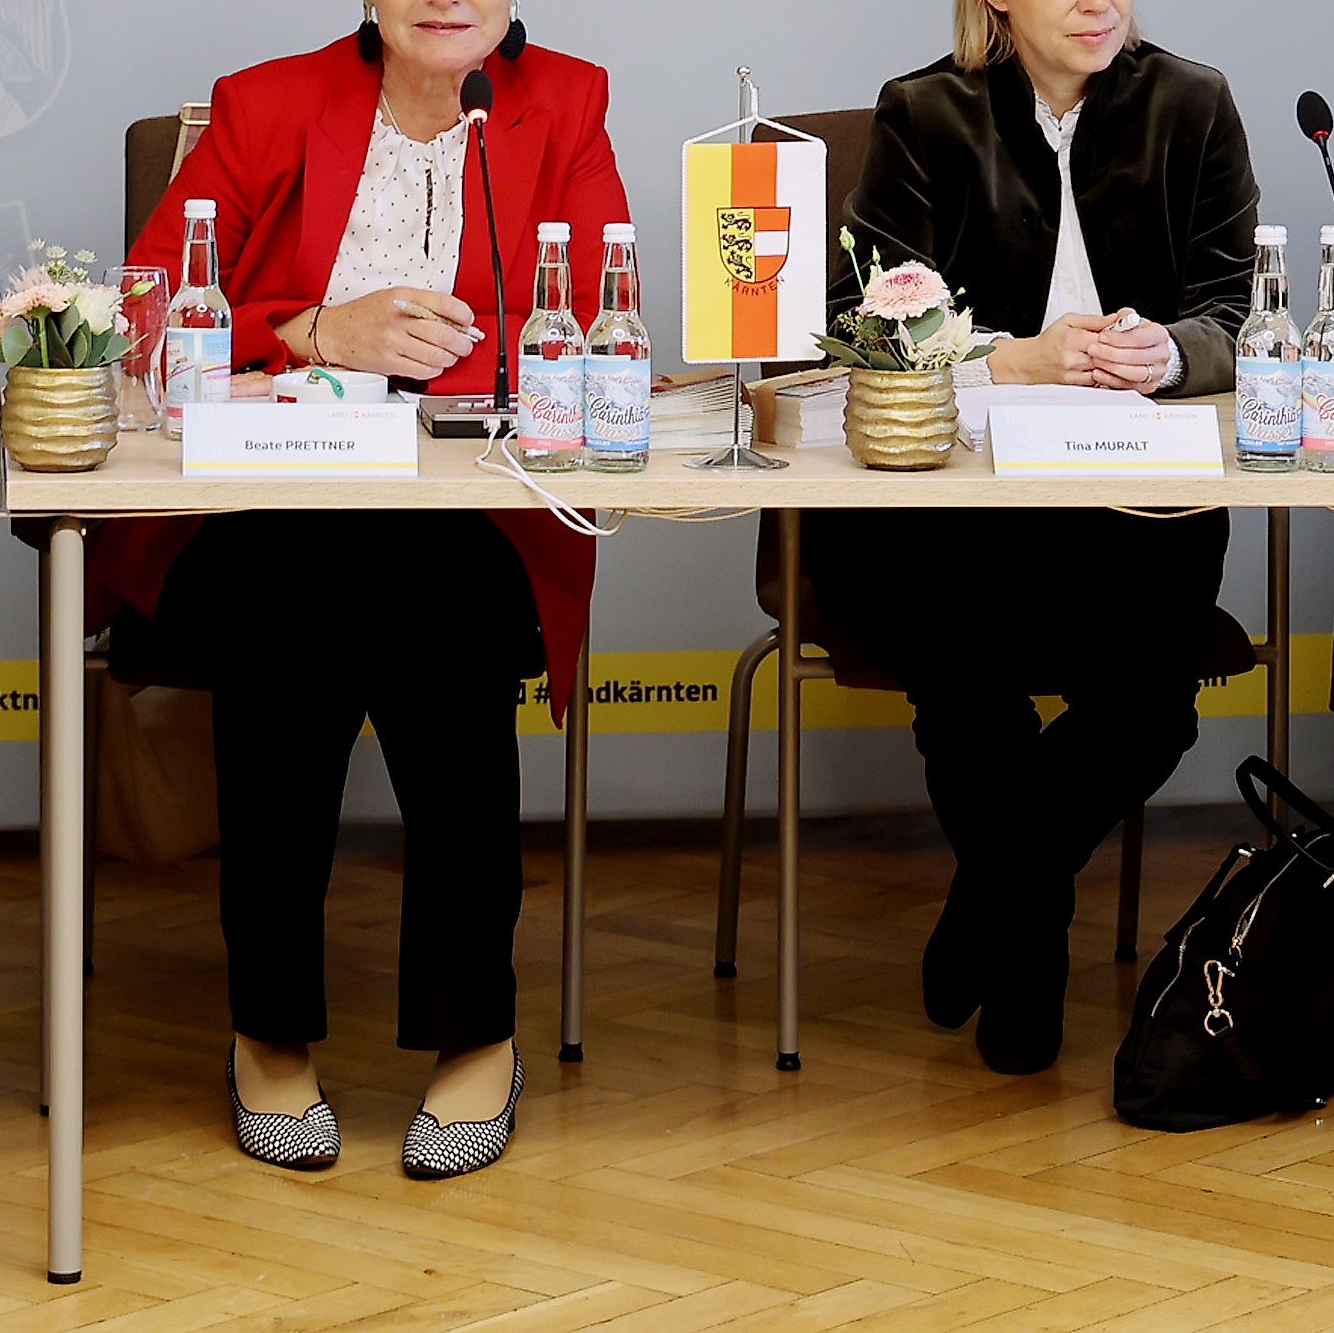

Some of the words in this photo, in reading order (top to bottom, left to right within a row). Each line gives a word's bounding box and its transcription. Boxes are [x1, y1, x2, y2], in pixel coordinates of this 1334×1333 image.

[245, 440, 283, 451] Beate
[285, 440, 355, 451] PRETTNER
[1064, 441, 1091, 451] Tina
[1095, 441, 1149, 452] MURALT
